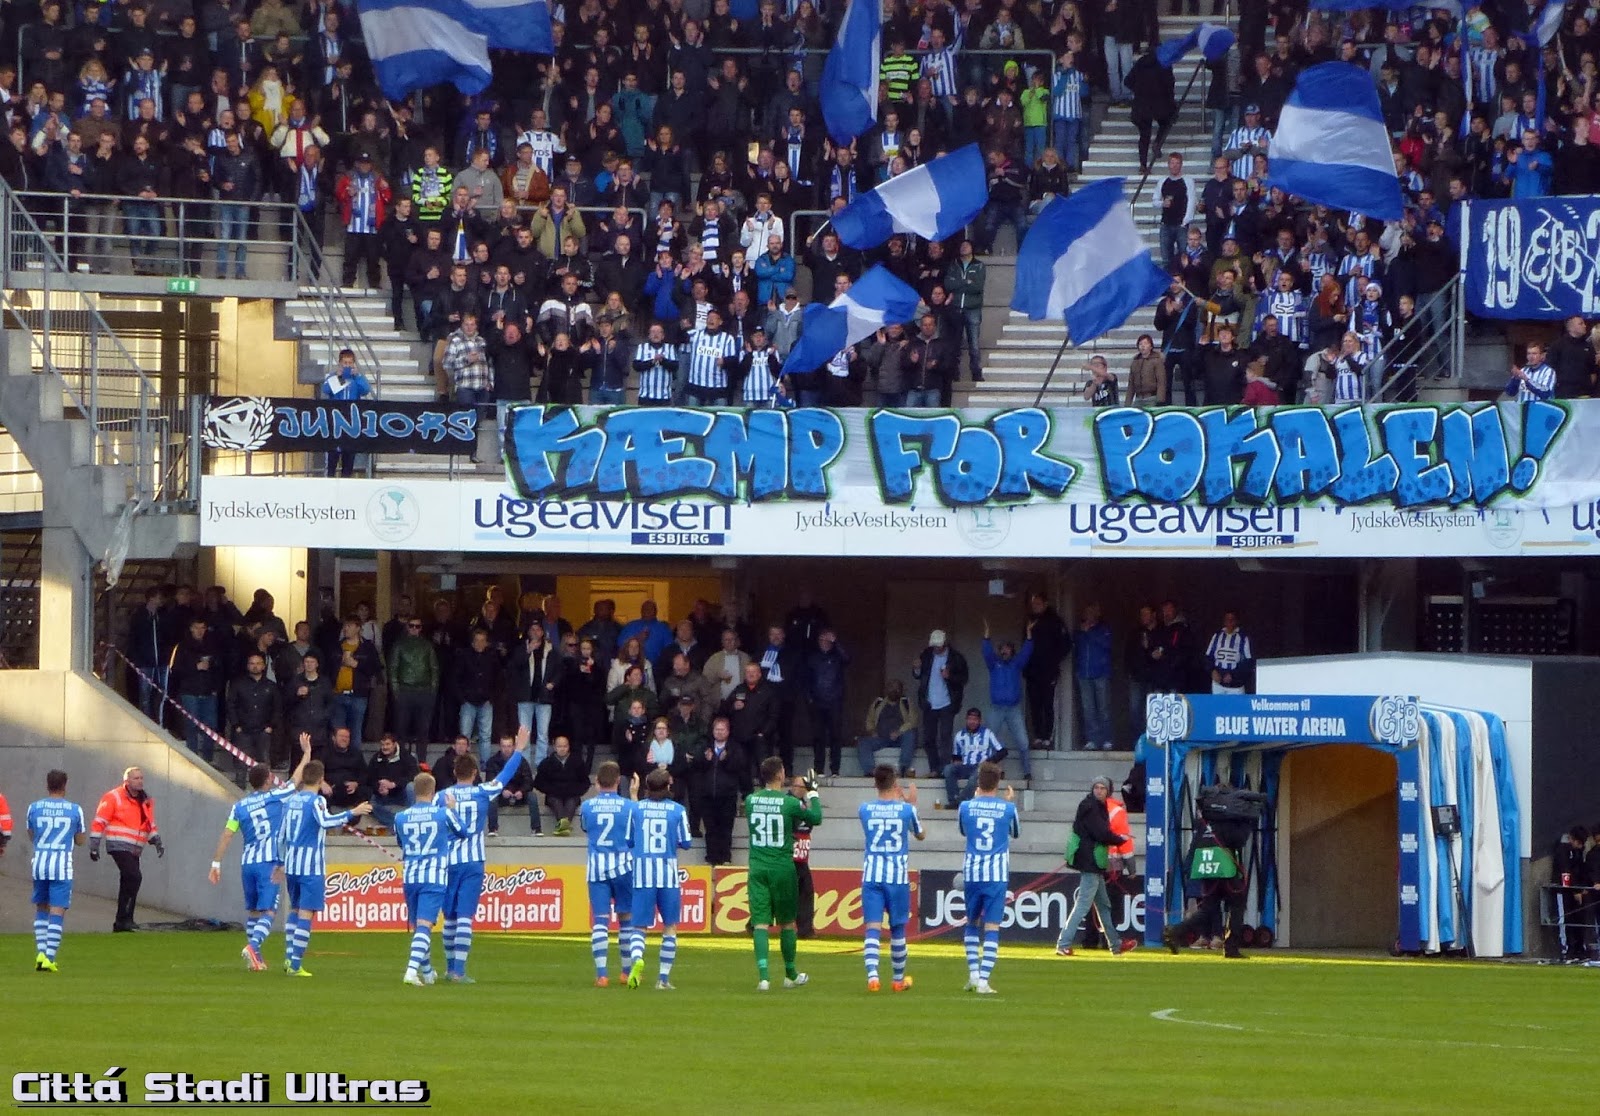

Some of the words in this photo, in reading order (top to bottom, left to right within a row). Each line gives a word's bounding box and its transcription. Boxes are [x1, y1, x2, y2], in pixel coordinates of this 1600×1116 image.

[274, 403, 478, 443] JUNIORS
[208, 501, 357, 525] JydskeVestkysten
[474, 498, 732, 538] ugeavisen
[794, 505, 948, 532] JydskeVestkysten
[1069, 503, 1300, 544] ugeavisen
[1350, 509, 1477, 533] JydskeVestkysten
[648, 533, 710, 545] ESBJERG
[1231, 535, 1283, 548] ESBJERG
[1251, 699, 1299, 711] Velkommen
[1300, 699, 1311, 711] til
[1215, 716, 1249, 735] BLUE
[1252, 716, 1298, 736] WATER
[1301, 717, 1347, 737] ARENA
[36, 816, 71, 850] 22
[249, 807, 271, 841] 6
[286, 809, 304, 842] 17
[403, 821, 438, 856] 32
[597, 813, 614, 847] 2
[642, 818, 667, 854] 18
[750, 813, 784, 848] 30
[867, 818, 903, 852] 23
[975, 817, 995, 851] 3
[1198, 862, 1221, 874] 457
[1202, 849, 1214, 861] TV
[324, 868, 397, 898] Slagter
[475, 896, 561, 928] eilgaard
[925, 889, 1068, 930] Jesen
